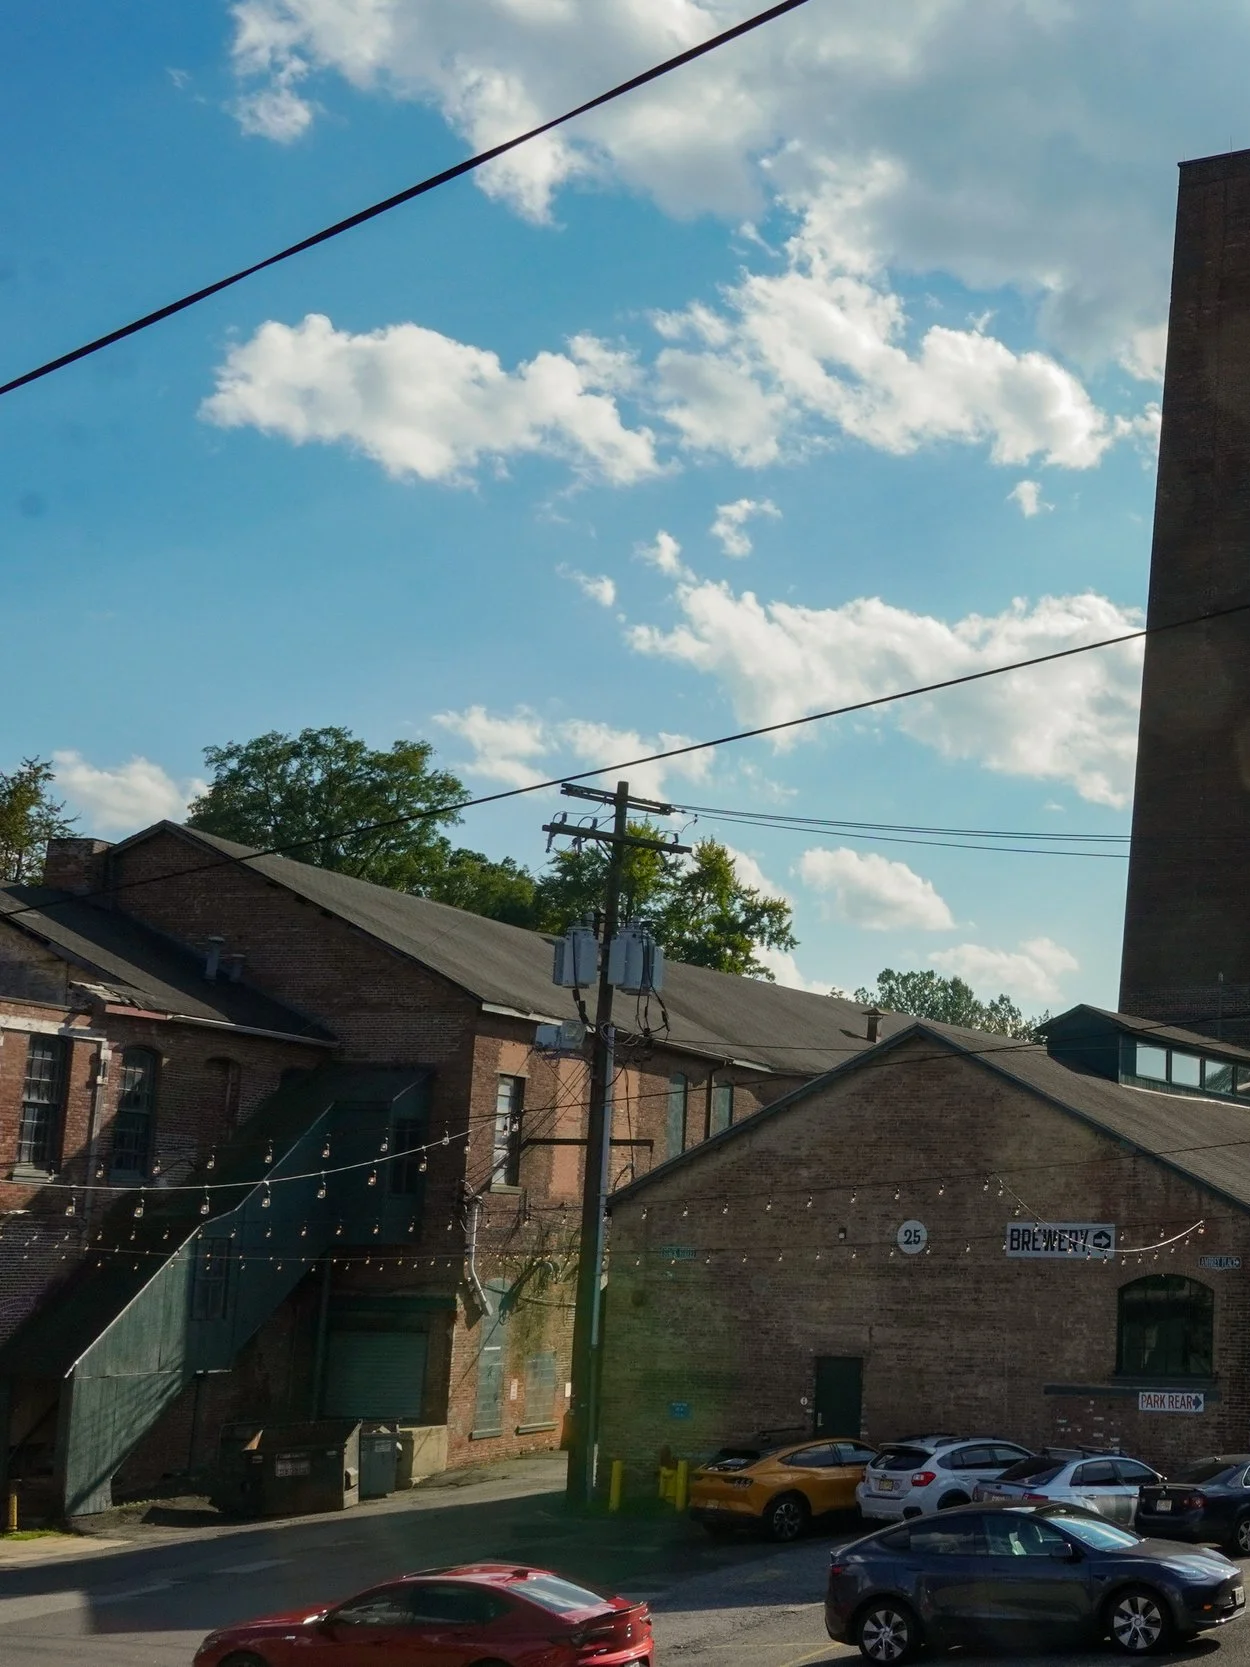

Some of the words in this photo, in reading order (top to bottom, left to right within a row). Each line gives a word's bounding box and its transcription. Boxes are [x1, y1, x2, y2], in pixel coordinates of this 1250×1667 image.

[903, 1229, 921, 1245] 25
[1010, 1228, 1088, 1252] BREWERY
[1141, 1394, 1166, 1408] PARK
[1168, 1395, 1193, 1409] REAR
